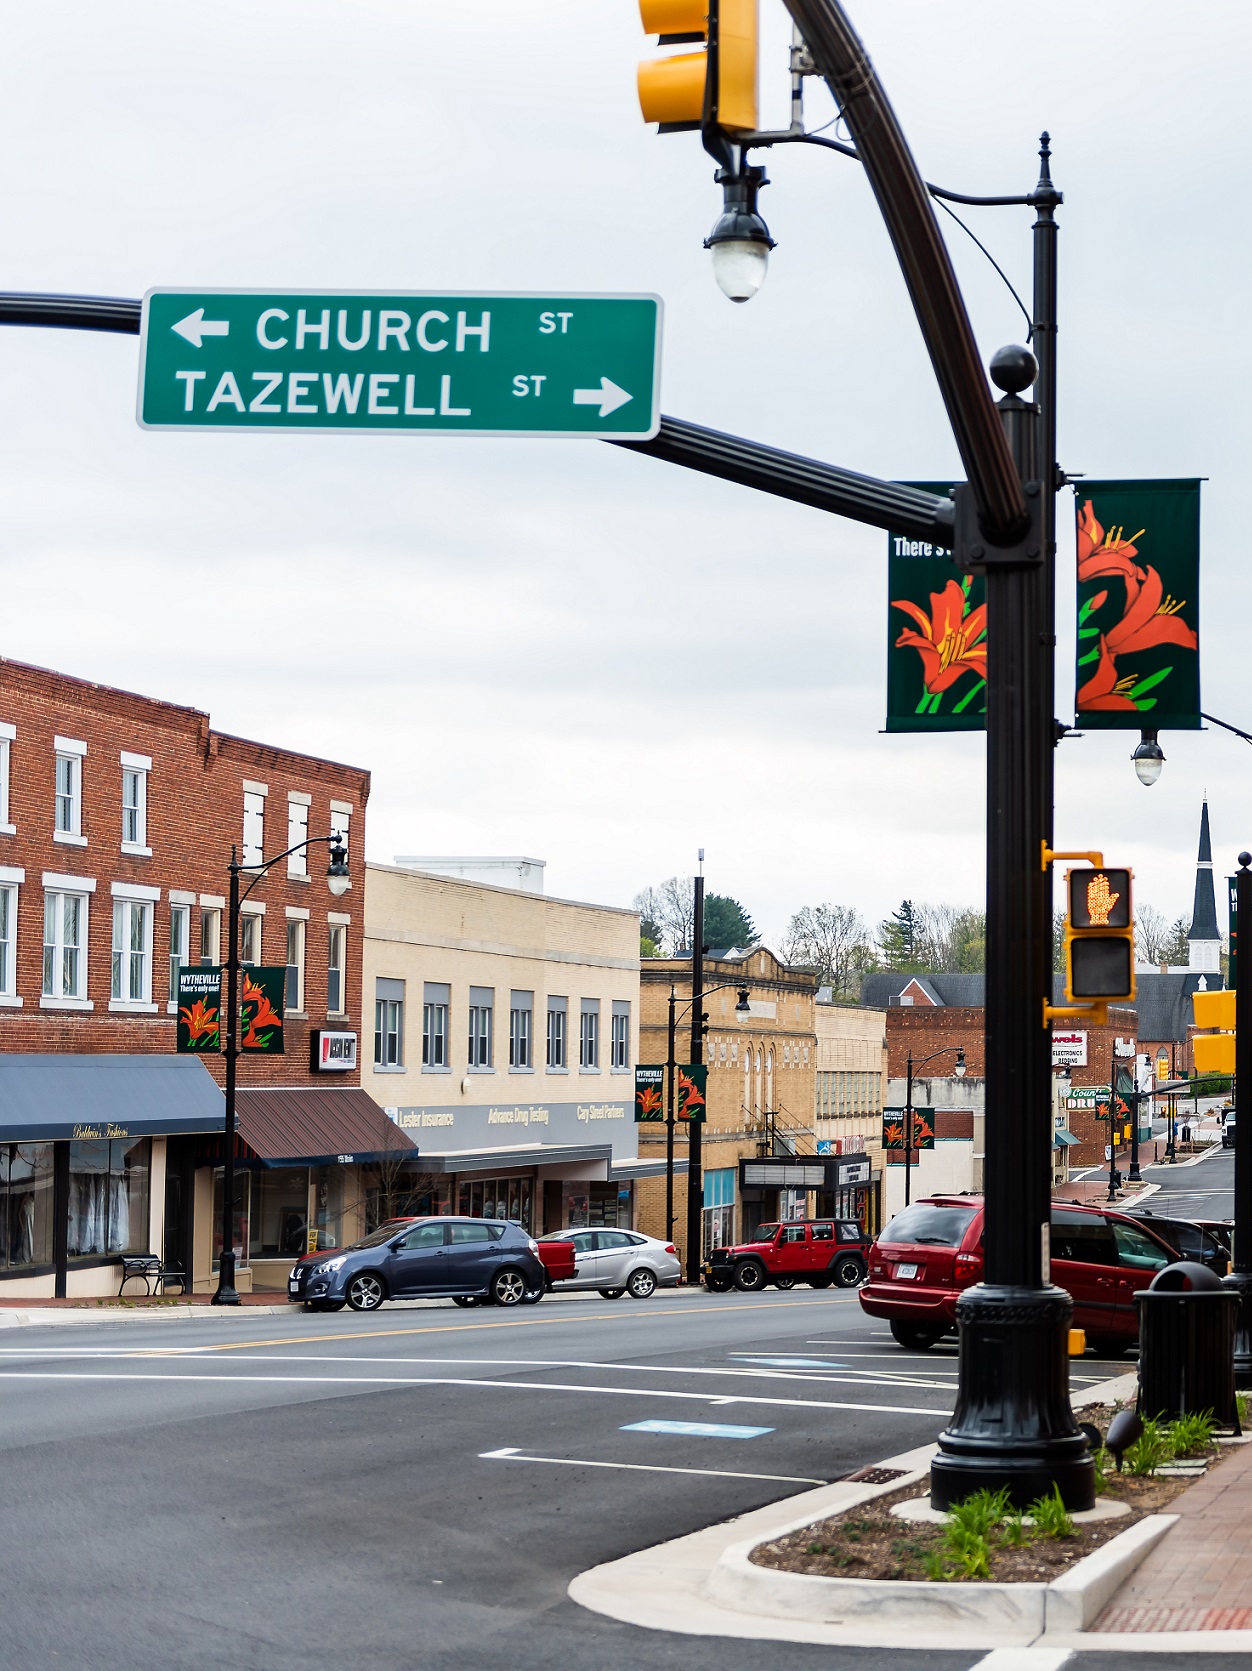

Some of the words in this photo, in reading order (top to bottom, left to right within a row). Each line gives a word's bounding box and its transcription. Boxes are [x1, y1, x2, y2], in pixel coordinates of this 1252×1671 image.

[256, 308, 491, 353] CHURCH
[538, 311, 574, 335] ST
[175, 370, 472, 417] TAZEWELL
[512, 374, 547, 397] ST
[893, 536, 944, 556] Theres
[180, 974, 221, 984] WYTHEVILLE
[1067, 1098, 1095, 1108] DRU
[400, 1110, 421, 1128] Lester
[422, 1110, 454, 1127] Insurance
[488, 1107, 514, 1125] Advance
[514, 1106, 529, 1127] Drug
[529, 1106, 549, 1126] Testing
